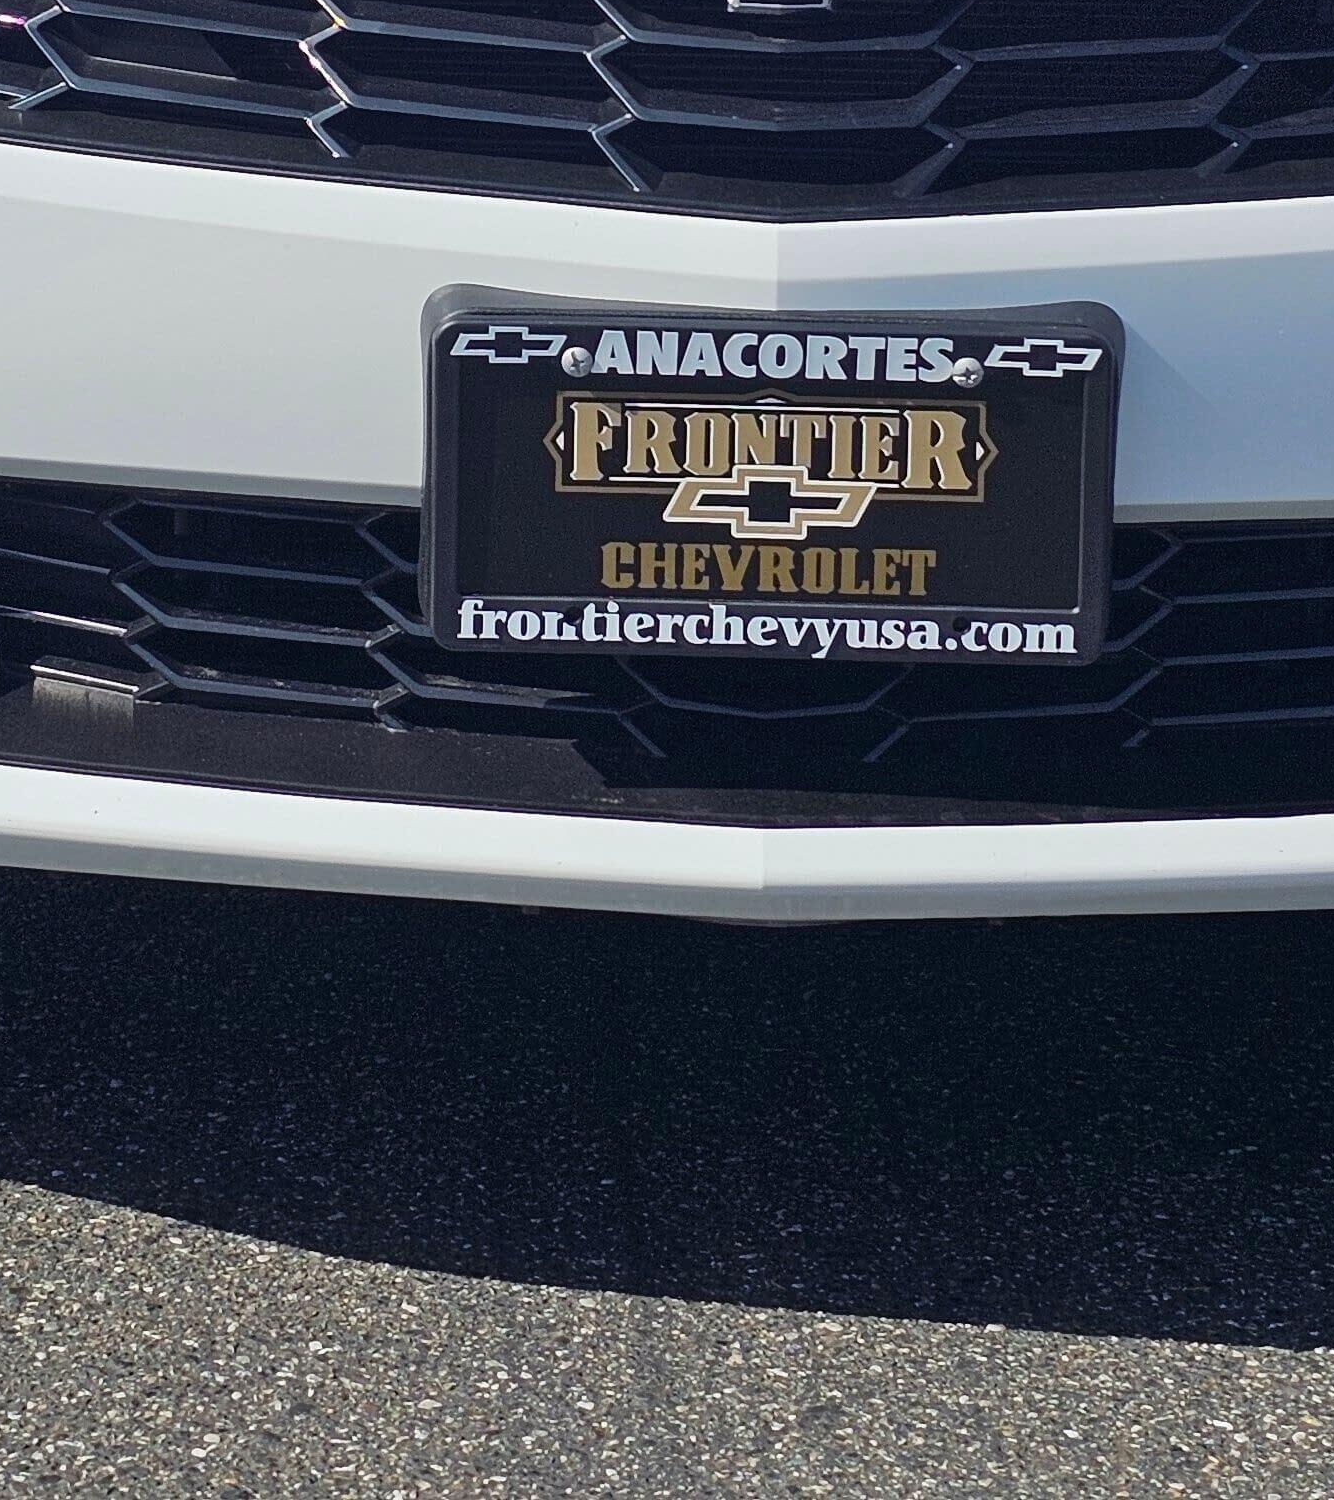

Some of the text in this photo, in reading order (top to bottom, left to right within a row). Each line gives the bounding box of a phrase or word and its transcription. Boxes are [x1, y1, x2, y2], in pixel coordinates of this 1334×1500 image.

[592, 329, 955, 384] ANACORTES
[569, 401, 973, 490] FRONTIER
[600, 541, 938, 596] CHEVROLET
[456, 598, 1079, 659] frontierchevyusa.com
